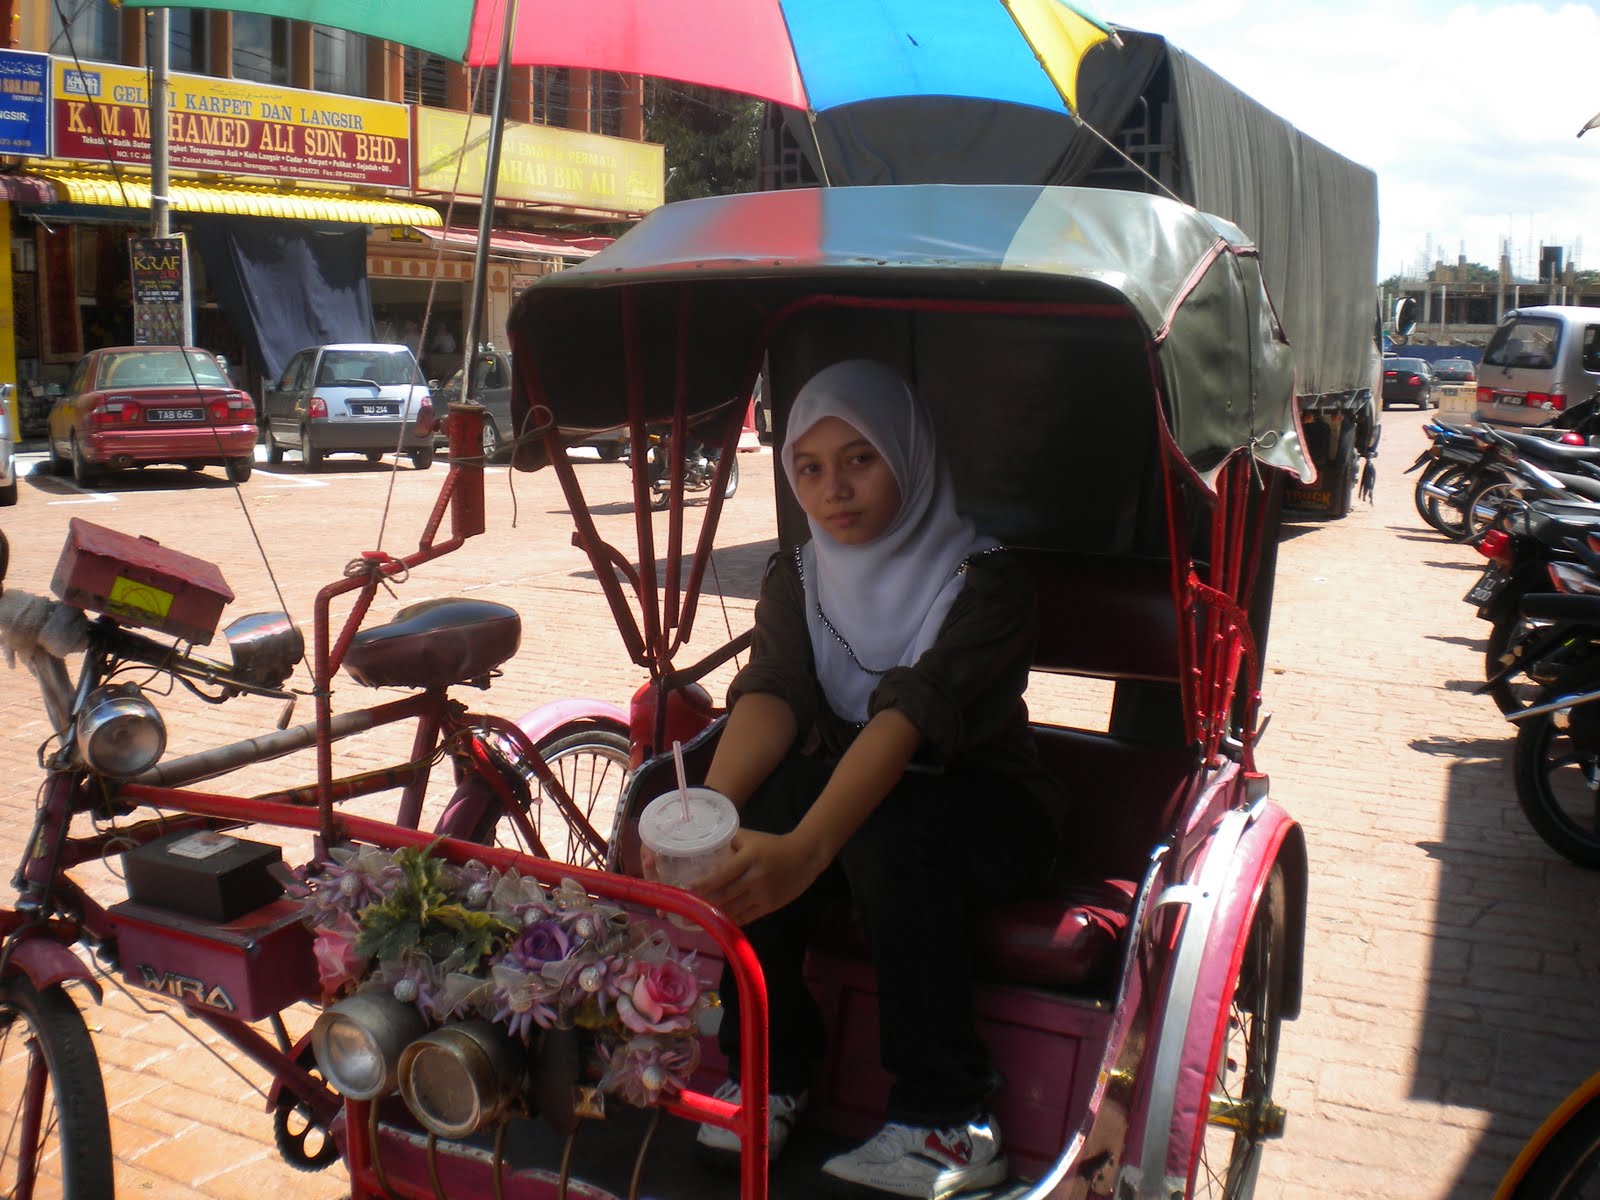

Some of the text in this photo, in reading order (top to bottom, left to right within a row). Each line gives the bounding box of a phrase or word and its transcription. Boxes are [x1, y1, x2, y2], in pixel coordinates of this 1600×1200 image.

[113, 85, 176, 108] GELI
[185, 93, 252, 116] KARPET
[261, 103, 292, 121] DAN
[300, 108, 363, 130] LANGSIR
[67, 102, 401, 165] K. M. MHAMED ALI SDN. BHD.
[113, 138, 132, 148] Batik
[133, 140, 152, 149] Suter
[189, 146, 225, 157] Terengganu
[226, 149, 239, 157] Asli
[243, 150, 258, 158] Kain
[259, 152, 280, 162] Langsir
[286, 155, 303, 163] Cadar
[308, 158, 328, 167] Karpet
[182, 156, 200, 165] Zainal
[225, 160, 242, 168] Kuala
[590, 171, 616, 196] ALI
[133, 255, 180, 270] KRAF
[157, 410, 194, 419] TAB 645
[376, 405, 388, 413] 214
